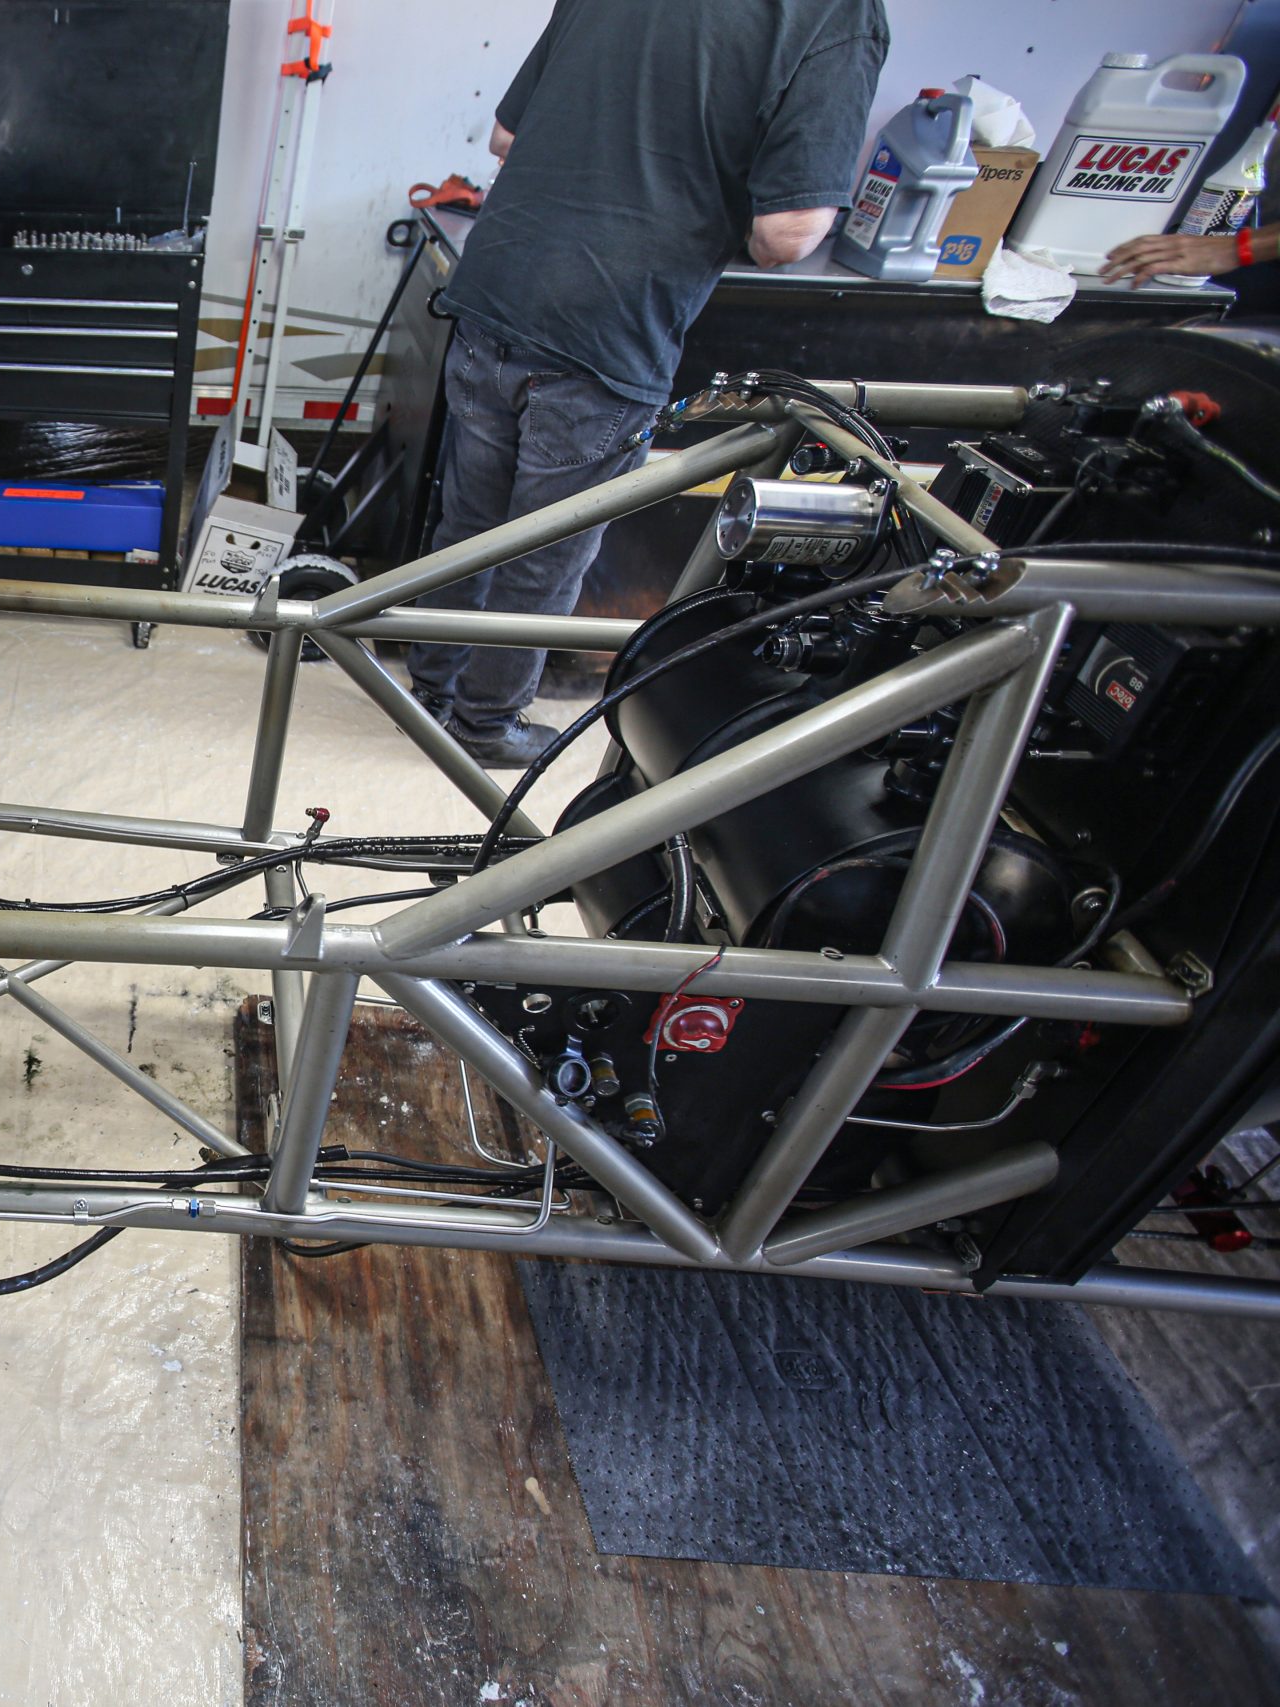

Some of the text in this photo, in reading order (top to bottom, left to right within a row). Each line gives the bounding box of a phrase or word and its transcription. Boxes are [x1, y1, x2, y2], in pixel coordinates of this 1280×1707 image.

[1075, 144, 1190, 175] LUCAS
[865, 179, 894, 198] RACING
[1066, 172, 1173, 194] RACING OIL
[941, 239, 976, 261] pig
[195, 573, 260, 594] LUCAS
